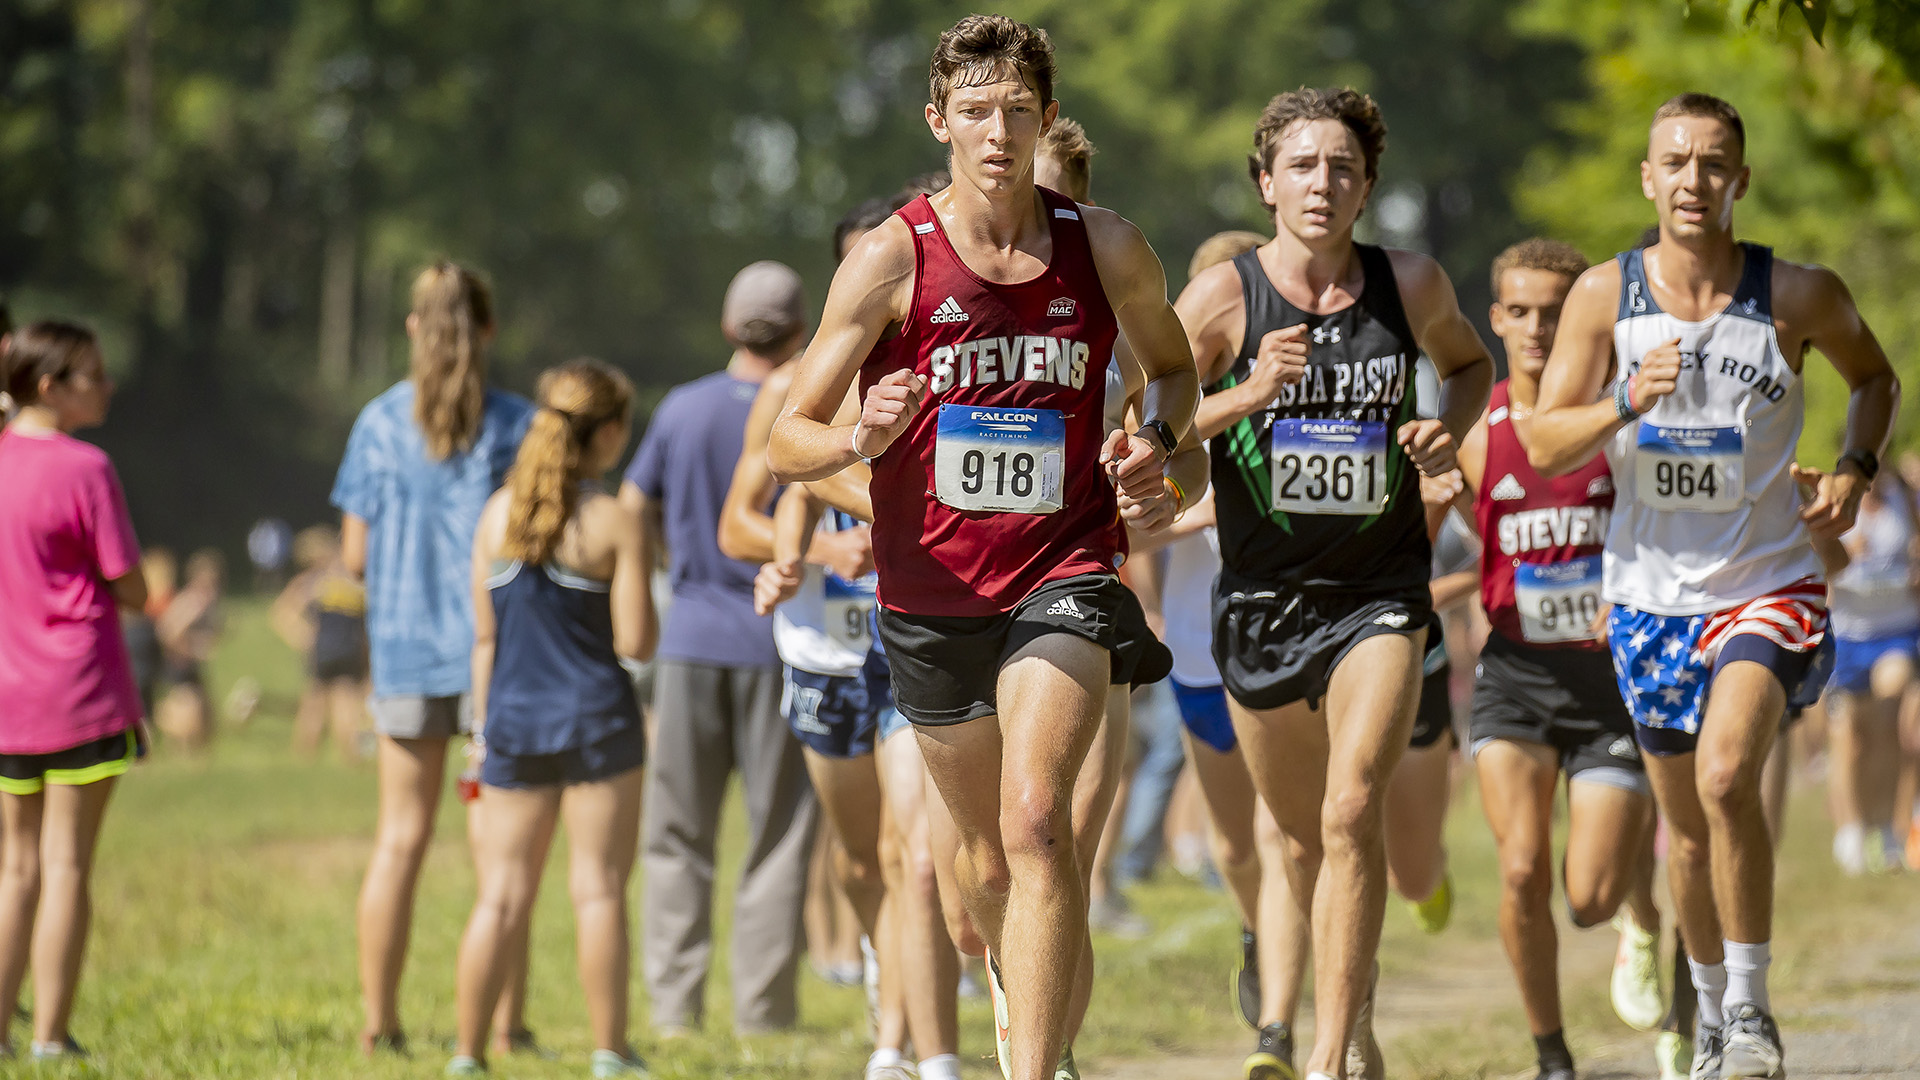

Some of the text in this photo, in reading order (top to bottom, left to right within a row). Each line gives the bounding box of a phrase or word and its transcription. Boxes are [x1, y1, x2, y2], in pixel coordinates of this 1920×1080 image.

[930, 312, 969, 324] adidas
[1049, 306, 1072, 314] MAC
[930, 335, 1090, 395] STEVENS
[1333, 352, 1406, 406] PASTA
[1719, 356, 1786, 403] ROAD
[970, 411, 1038, 423] FALCON
[1001, 432, 1028, 440] TIMING
[1301, 423, 1363, 434] FALCON
[961, 449, 1035, 498] 918
[1280, 454, 1377, 502] 2361
[1656, 460, 1718, 498] 964
[1498, 506, 1612, 557] STEVEN
[1046, 606, 1085, 619] adidas
[1539, 592, 1599, 631] 910
